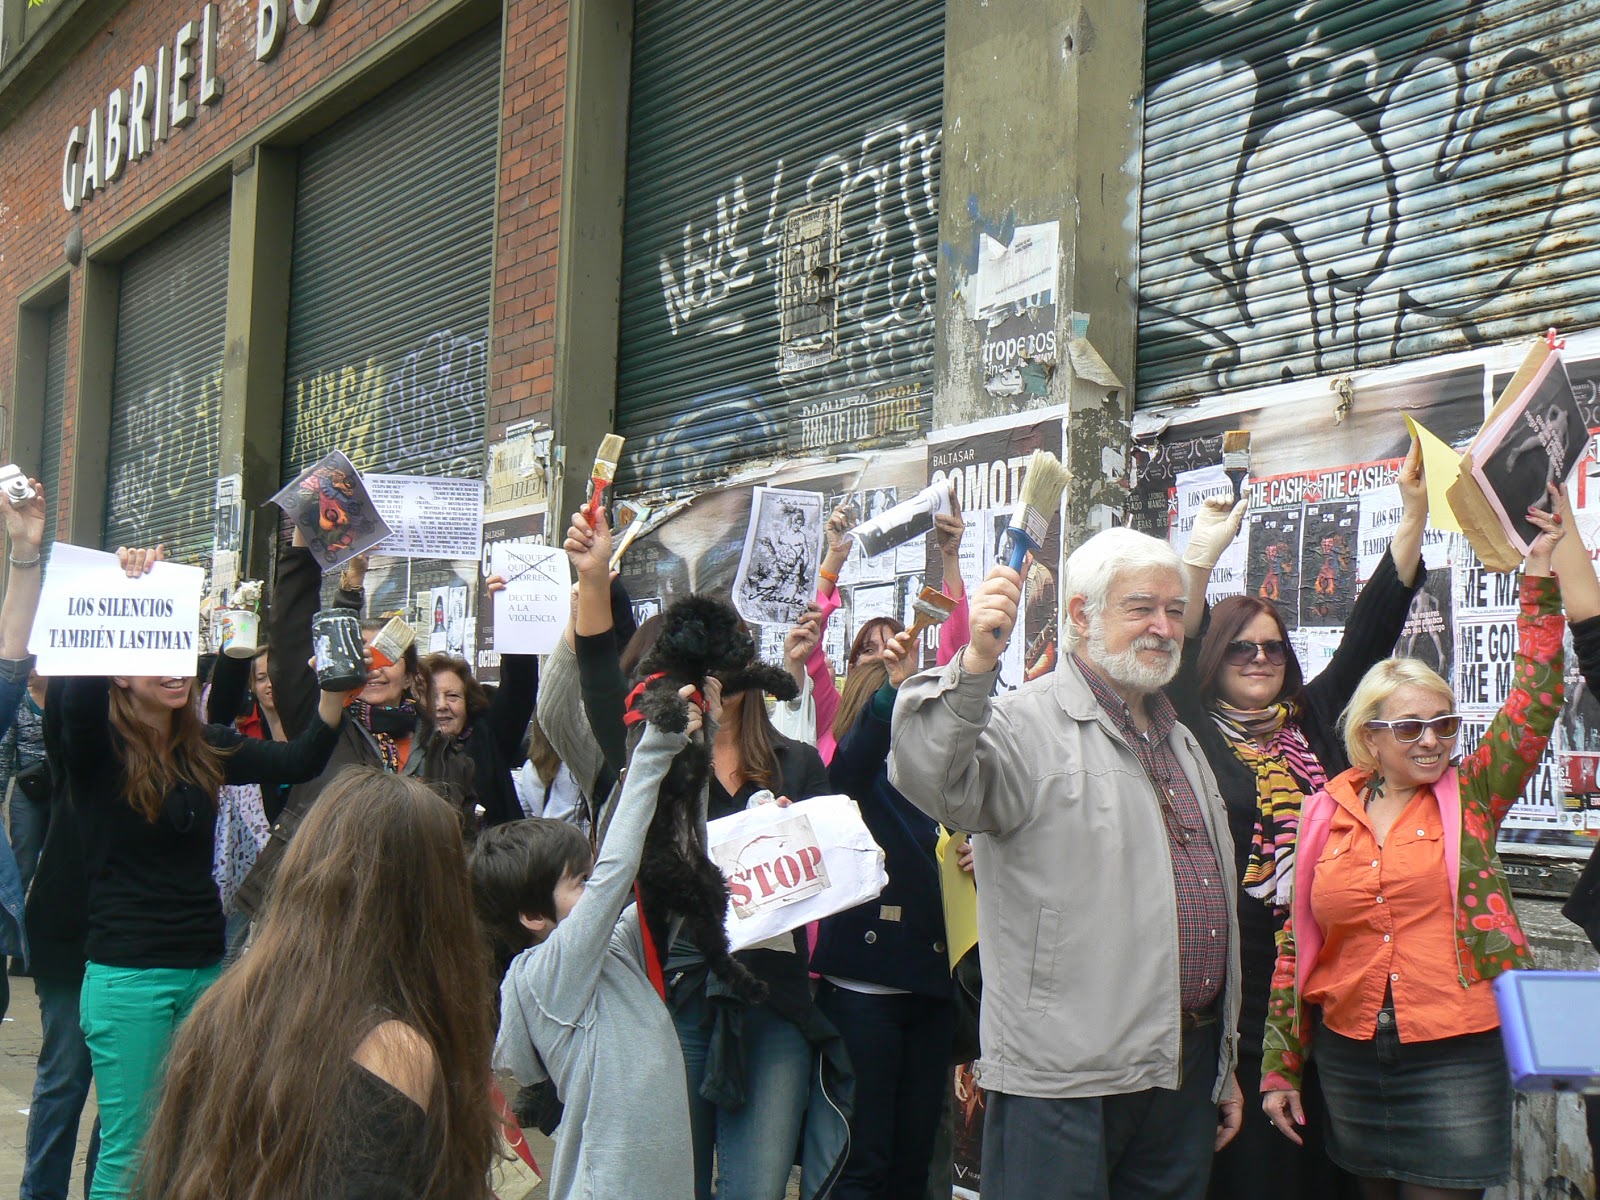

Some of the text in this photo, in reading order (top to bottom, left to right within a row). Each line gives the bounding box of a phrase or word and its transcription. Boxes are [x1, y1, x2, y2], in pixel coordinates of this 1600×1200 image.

[63, 3, 223, 211] GABRIEL
[933, 449, 974, 467] BALTASAR
[1188, 485, 1233, 507] LOS SILENCIO
[1270, 477, 1302, 505] CASH
[1321, 470, 1345, 499] THE
[1348, 466, 1383, 495] CASH
[1372, 512, 1386, 527] LOS
[508, 564, 541, 572] QUIEO
[68, 597, 173, 617] LOS SILENCIOS
[544, 594, 557, 602] NO
[508, 614, 557, 622] VIOLENCIA
[50, 625, 193, 650] TAMBIÉN LASTIMAN
[1461, 625, 1483, 663] ME
[1461, 664, 1488, 703] ME
[726, 846, 822, 907] STOP
